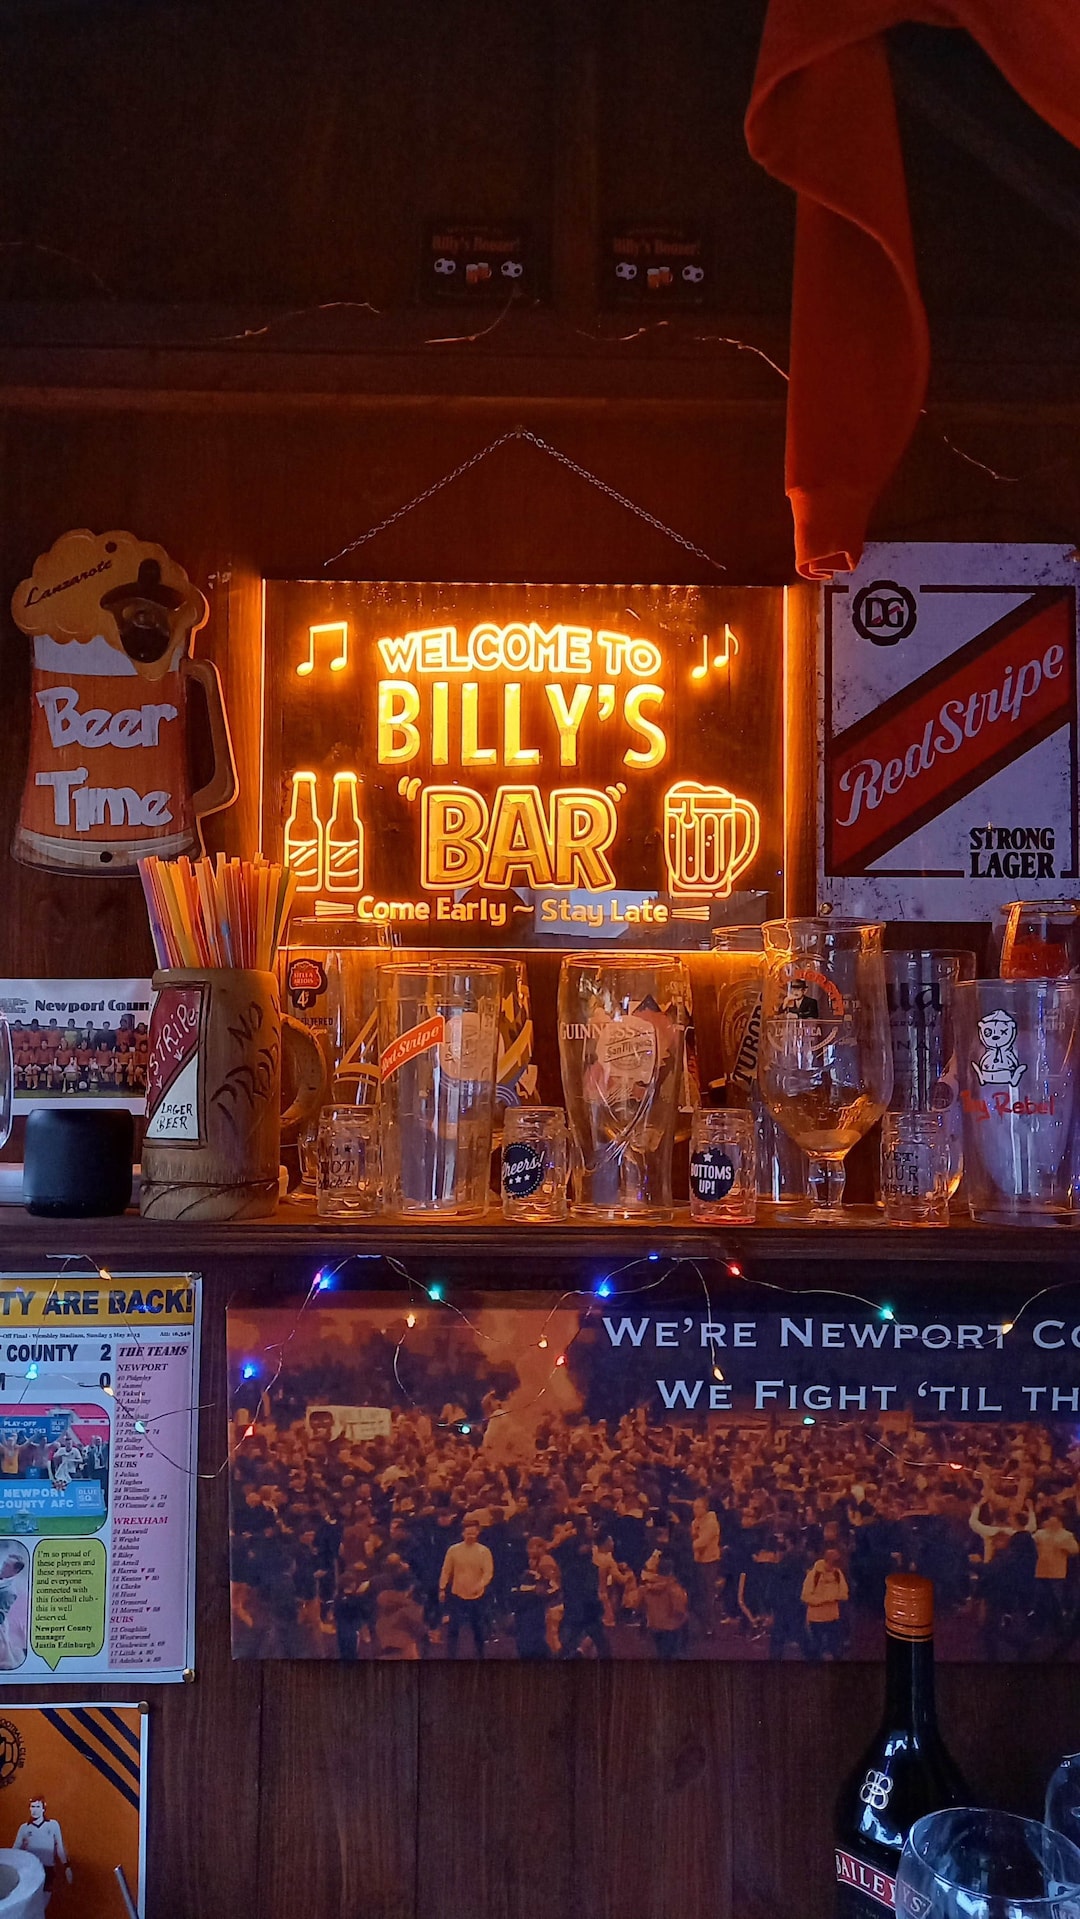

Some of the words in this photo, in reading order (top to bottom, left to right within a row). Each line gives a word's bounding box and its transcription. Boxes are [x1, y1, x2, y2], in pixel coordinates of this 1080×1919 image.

[24, 558, 113, 608] Lanzarote
[378, 622, 592, 675] WELCOME
[597, 631, 662, 677] TO
[35, 686, 178, 748] Beer
[377, 680, 667, 769] BILLY'S
[35, 766, 173, 831] Time
[969, 827, 1055, 850] STRONG
[969, 852, 1055, 878] LAGER
[357, 896, 430, 921] Come
[436, 897, 506, 925] Early
[541, 899, 603, 926] Stay
[610, 900, 668, 923] Late
[35, 999, 105, 1013] Newport
[107, 1000, 152, 1011] Coun
[397, 1026, 441, 1058] Stripe
[161, 1102, 193, 1116] LAGER
[992, 1091, 1056, 1118] Rebel
[157, 1116, 188, 1132] BEER
[691, 1163, 732, 1180] BOTTOMS
[699, 1179, 715, 1195] UP!
[43, 1290, 98, 1315] ARE
[108, 1289, 192, 1314] BACK!
[32, 1332, 58, 1340] Wembley
[602, 1316, 758, 1348] WE'RE
[780, 1317, 1006, 1350] NEWPORT
[7, 1344, 78, 1362] COUNTY
[100, 1343, 111, 1361] 2
[119, 1347, 144, 1356] THE
[147, 1345, 188, 1356] TEAMS
[117, 1363, 168, 1371] NEWPORT
[100, 1373, 111, 1388] 0
[656, 1379, 733, 1410] WE
[754, 1379, 897, 1411] FIGHT
[917, 1381, 1002, 1412] 'TIL
[1022, 1386, 1080, 1412] TH
[4, 1488, 65, 1498] NEWPORT
[0, 1499, 46, 1509] COUNTY
[51, 1499, 74, 1508] AFC
[114, 1516, 168, 1525] WREXHAM
[61, 1551, 81, 1559] proud
[51, 1578, 82, 1586] everyone
[35, 1625, 65, 1633] Newport
